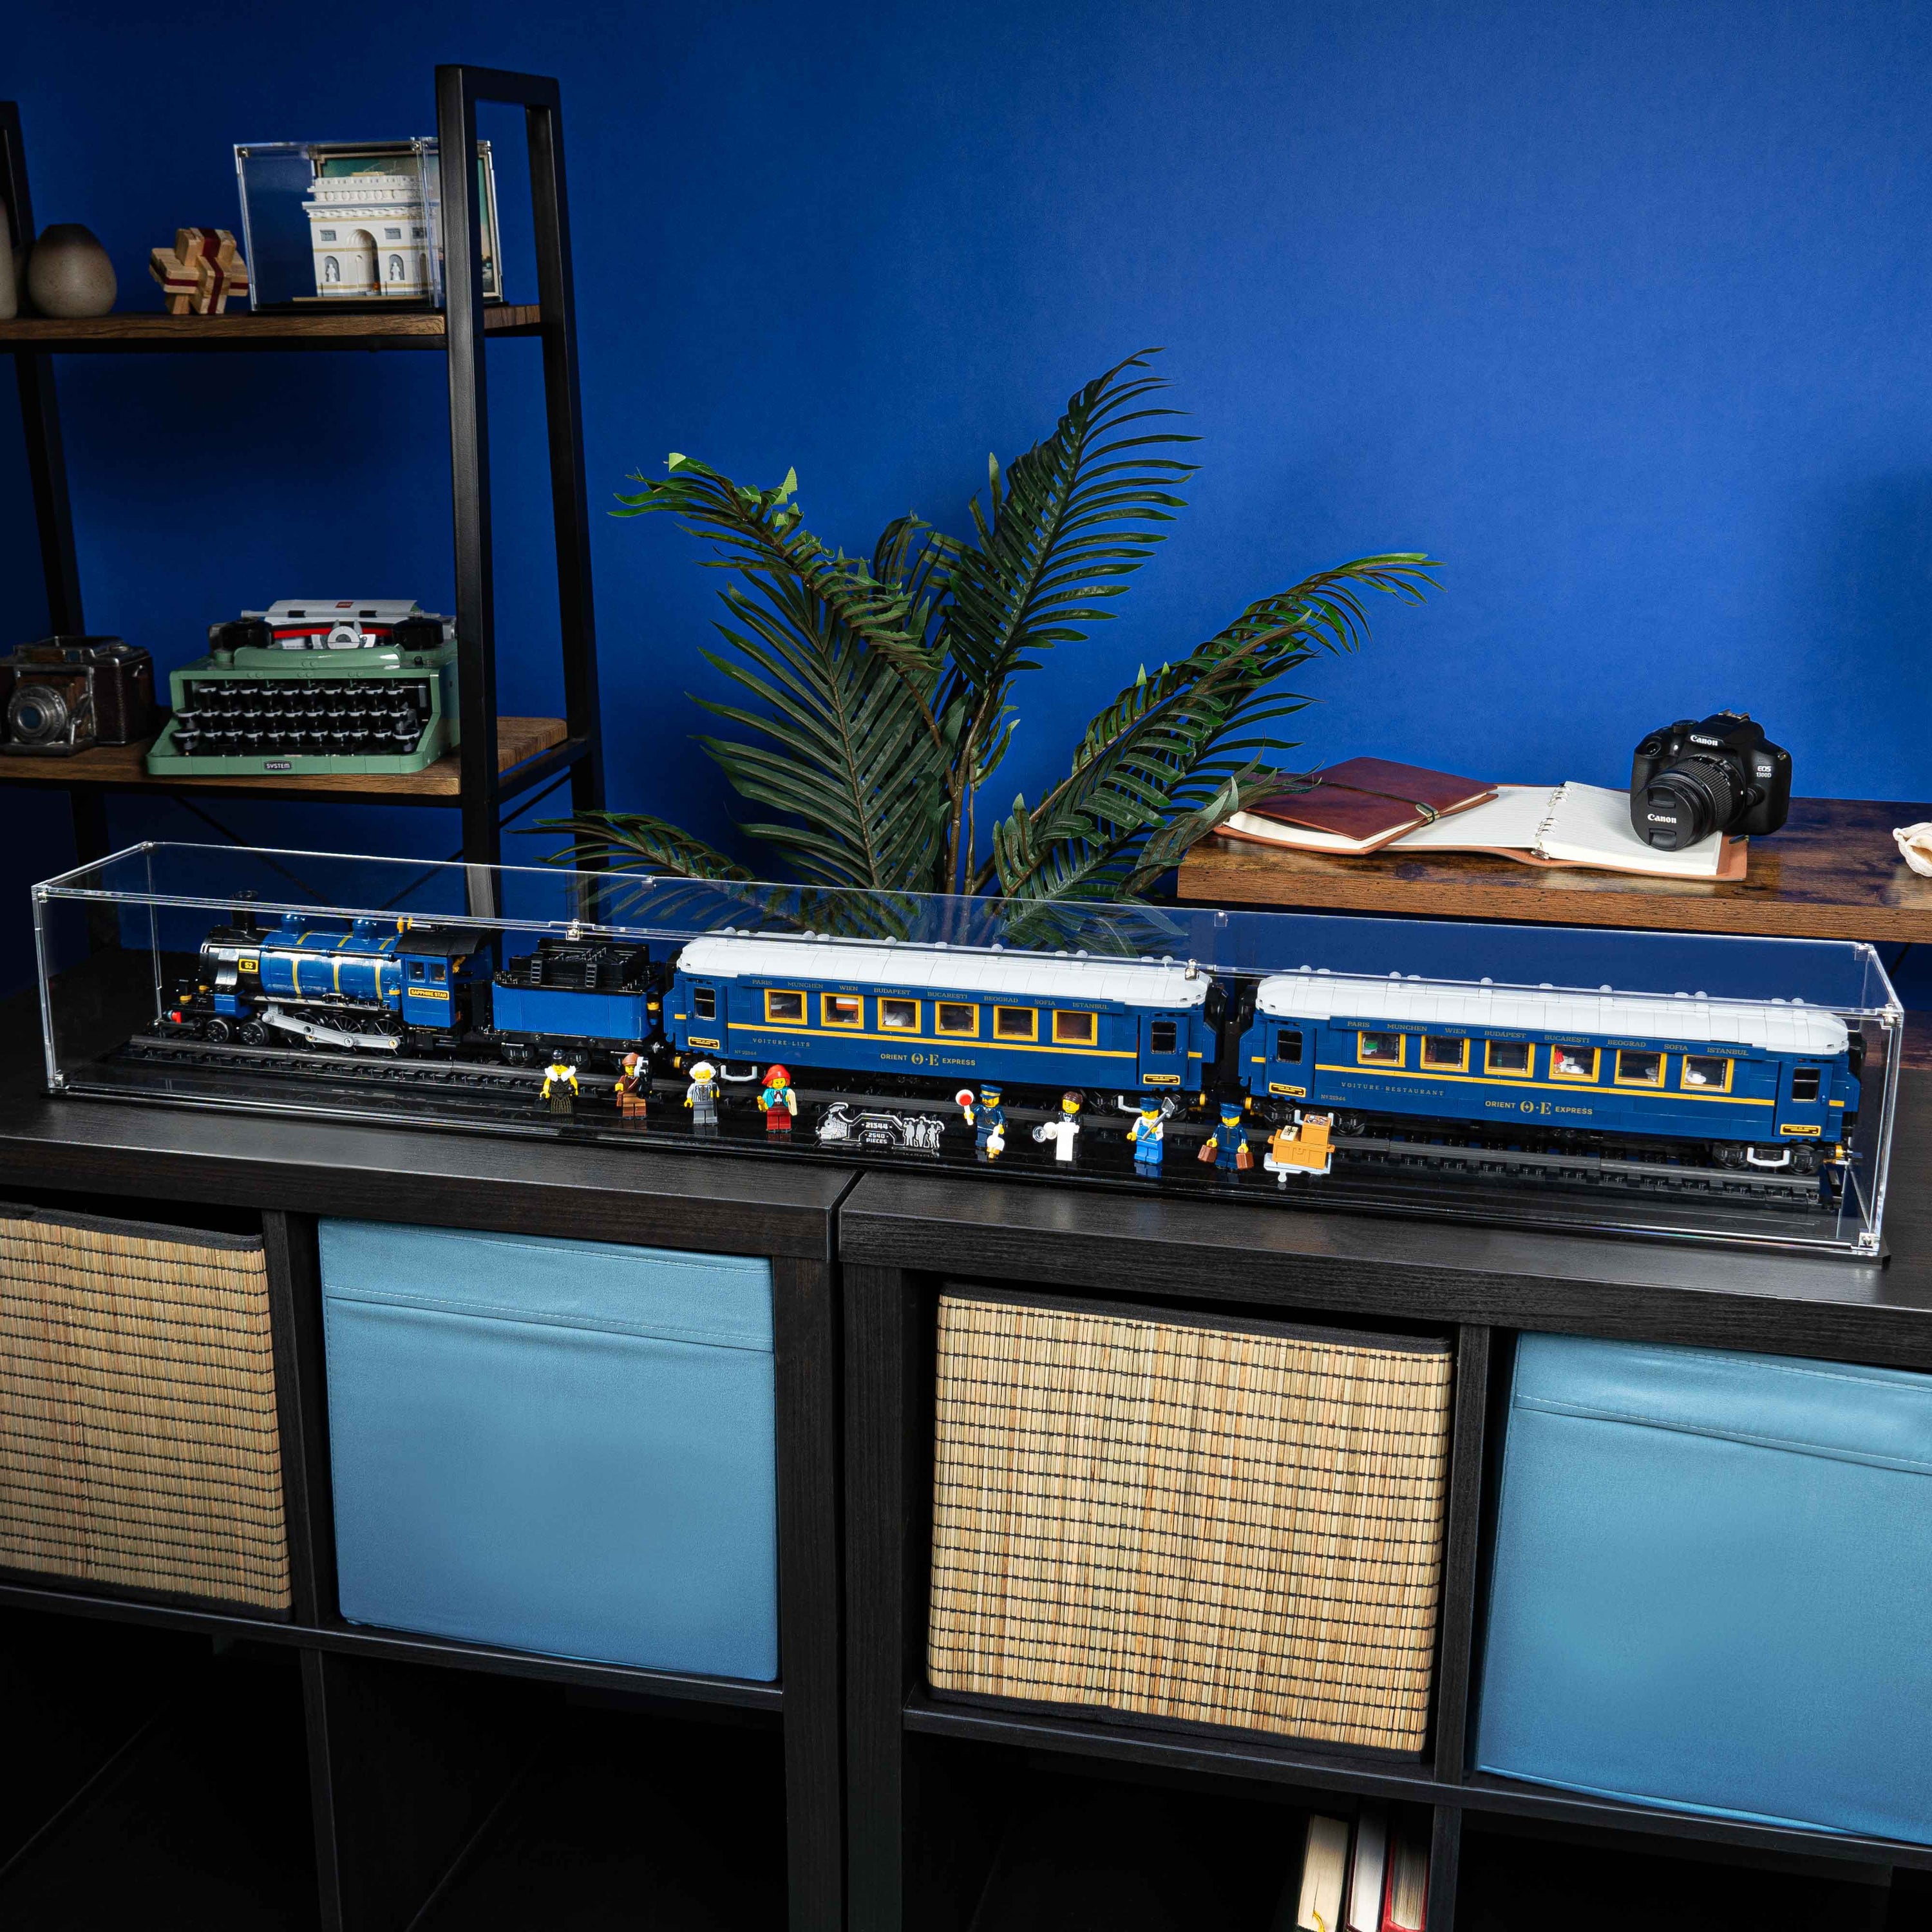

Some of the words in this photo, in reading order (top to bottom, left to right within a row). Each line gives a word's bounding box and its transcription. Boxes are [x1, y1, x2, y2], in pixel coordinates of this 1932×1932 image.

[1690, 735, 1718, 746] Canon
[1647, 813, 1677, 824] Canon
[873, 987, 911, 996] BUDAPEST
[983, 995, 1019, 1003] BEOGRAD
[1484, 1030, 1526, 1039] BUDAPEST
[1607, 1039, 1647, 1047] BEOGRAD
[1707, 1046, 1749, 1056] ISTANBUL
[942, 1057, 976, 1066] EXPRESS
[1485, 1101, 1516, 1109] ORIENT
[1555, 1106, 1593, 1115] EXPRESS
